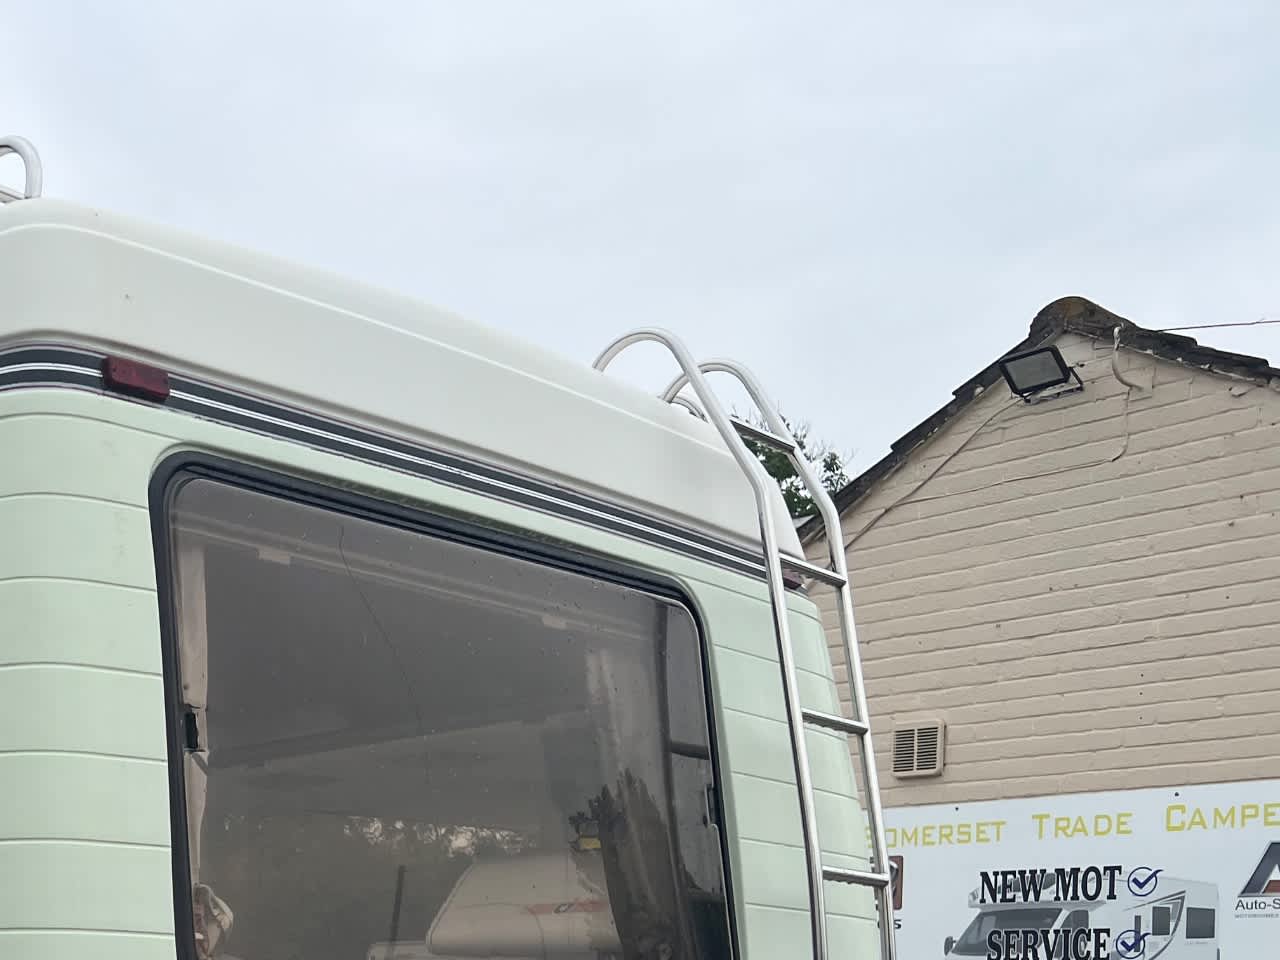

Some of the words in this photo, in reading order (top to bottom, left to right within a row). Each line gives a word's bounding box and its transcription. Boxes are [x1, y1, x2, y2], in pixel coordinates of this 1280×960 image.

[1031, 812, 1133, 840] TRADE
[979, 869, 1047, 904] NEW
[1053, 865, 1122, 902] MOT
